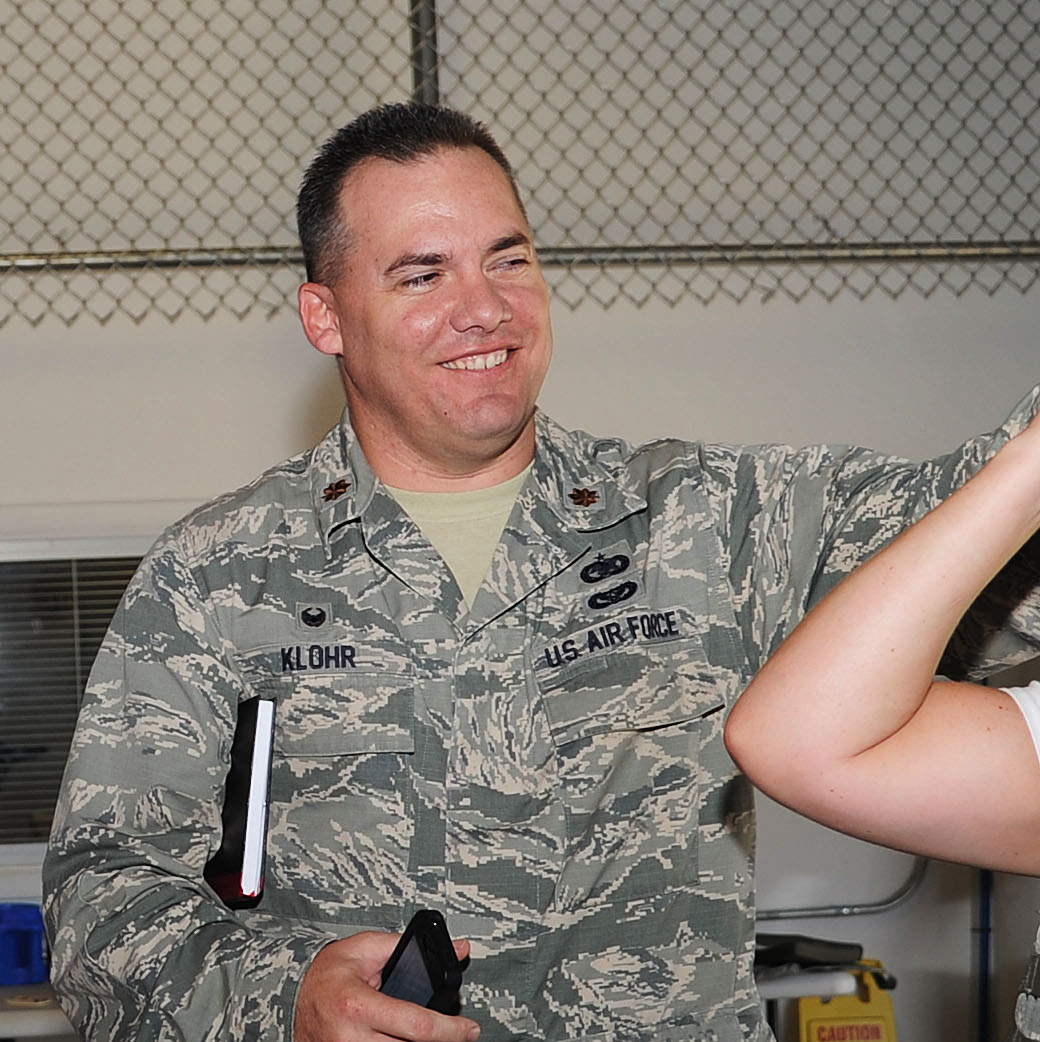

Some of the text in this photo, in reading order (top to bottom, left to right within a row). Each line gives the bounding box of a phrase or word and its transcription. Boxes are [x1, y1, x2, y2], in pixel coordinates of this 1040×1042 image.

[587, 622, 625, 653] AIR
[626, 611, 679, 640] FORCE
[281, 644, 357, 672] KLOHR
[817, 1024, 882, 1042] CAUTION
